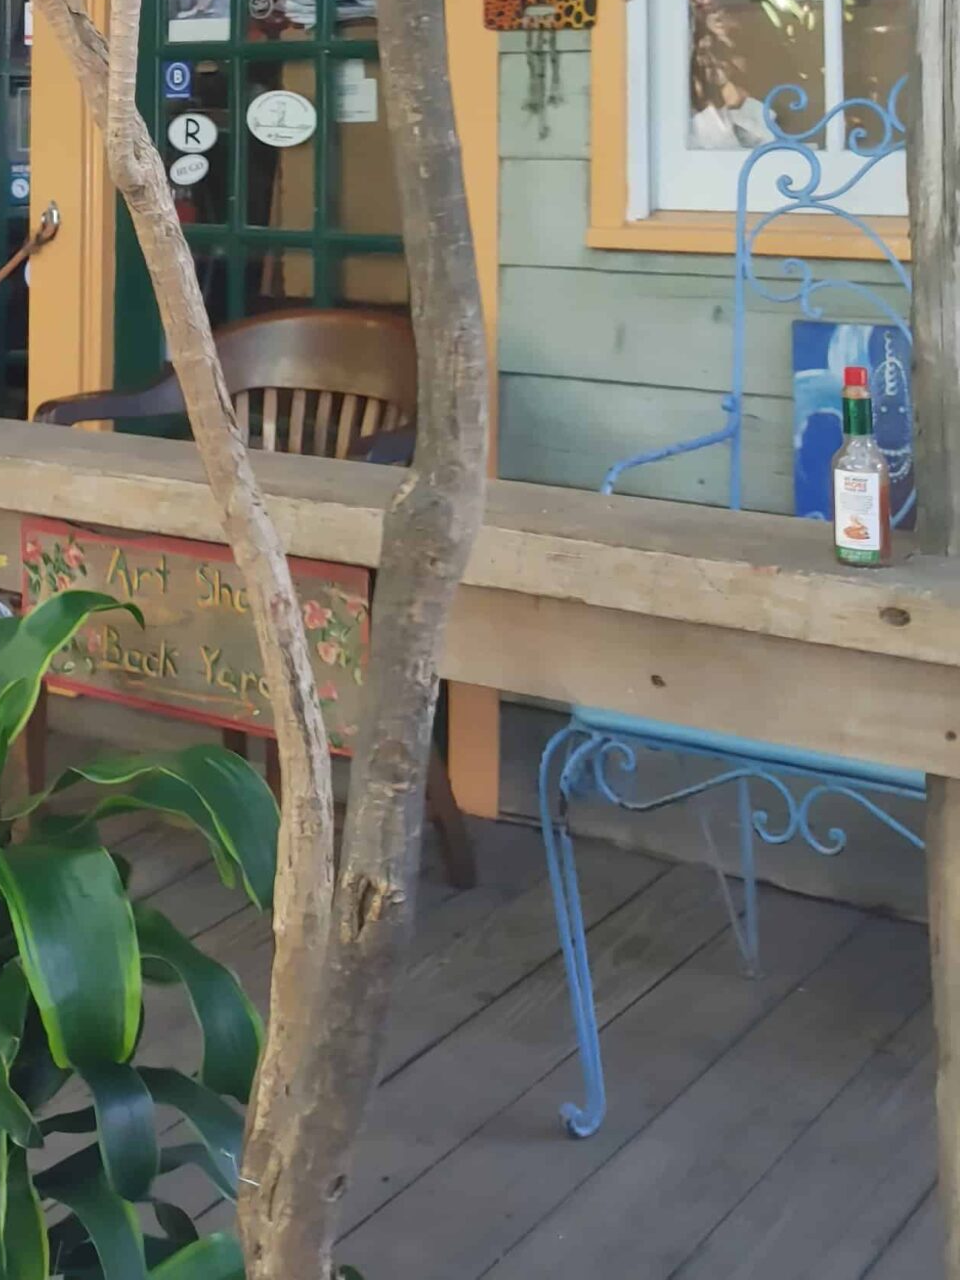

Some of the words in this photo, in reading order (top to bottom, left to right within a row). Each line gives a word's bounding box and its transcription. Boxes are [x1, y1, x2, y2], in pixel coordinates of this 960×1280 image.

[184, 117, 201, 145] R
[106, 546, 170, 599] Art
[195, 562, 251, 615] Sho
